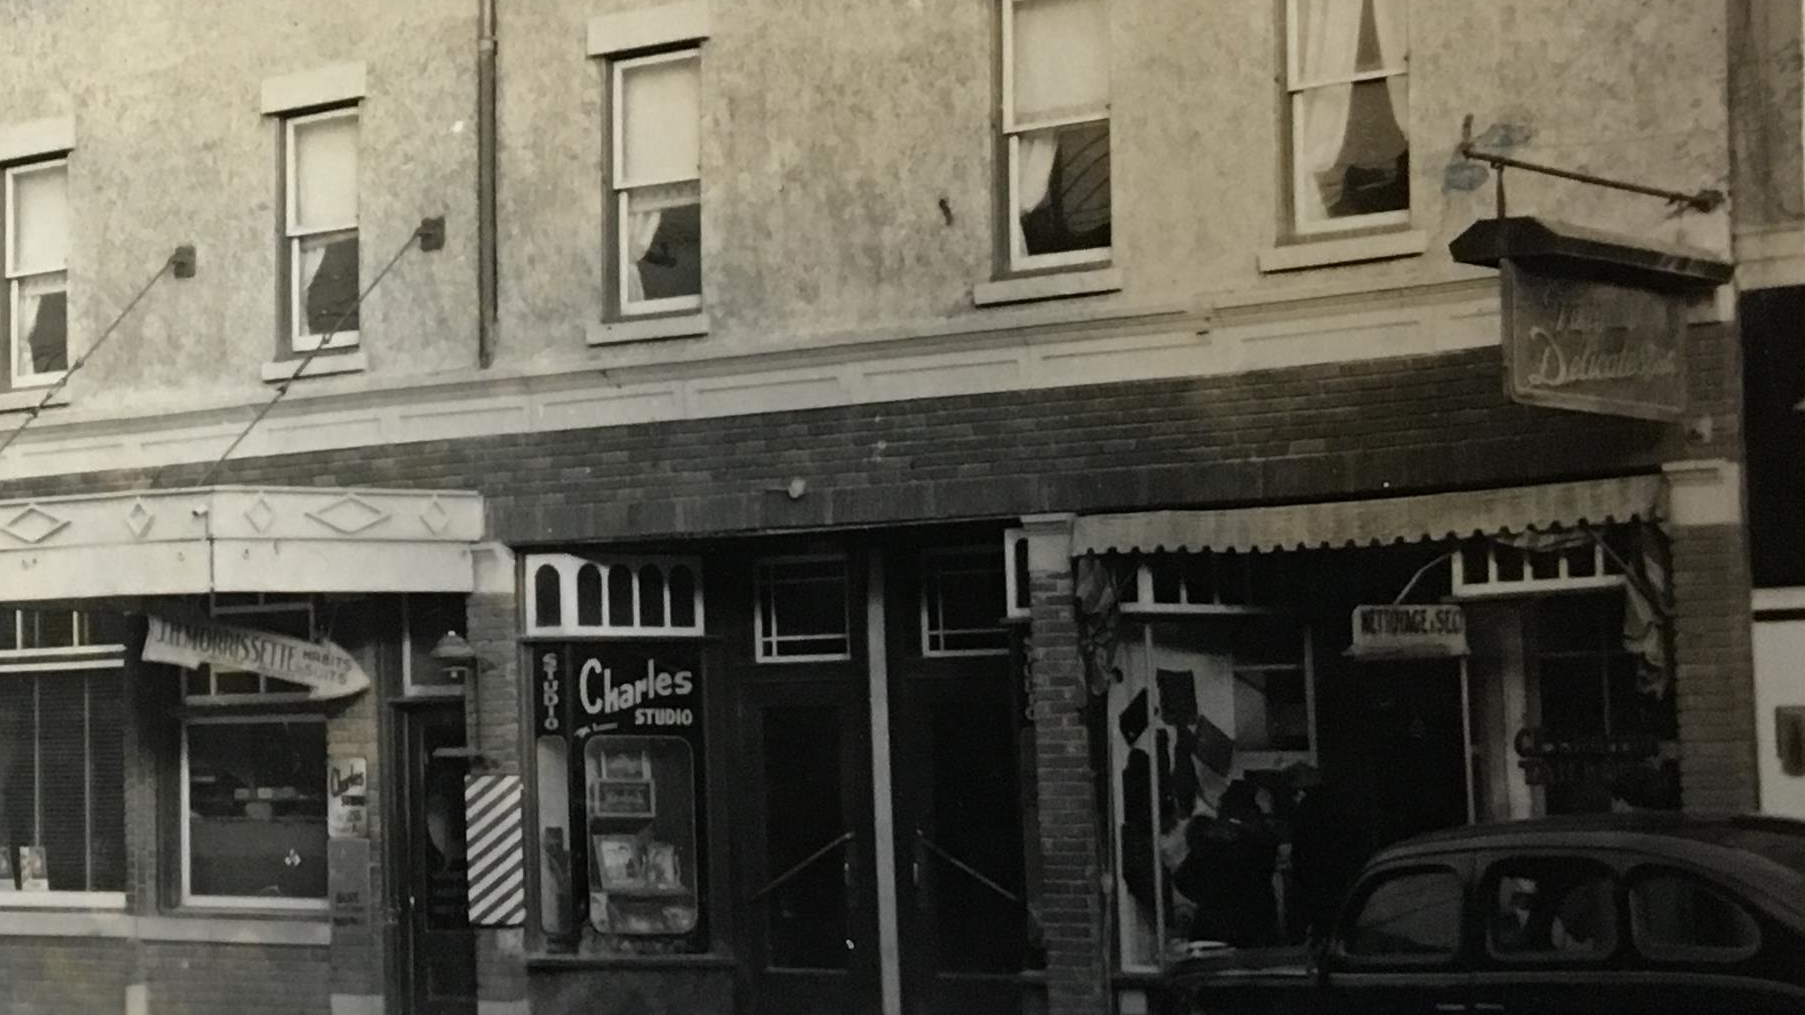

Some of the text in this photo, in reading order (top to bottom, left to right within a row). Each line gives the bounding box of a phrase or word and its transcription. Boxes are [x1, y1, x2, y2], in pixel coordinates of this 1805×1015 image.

[542, 652, 560, 731] STUDIO
[579, 657, 694, 715] Charles
[634, 707, 694, 726] STUDIO
